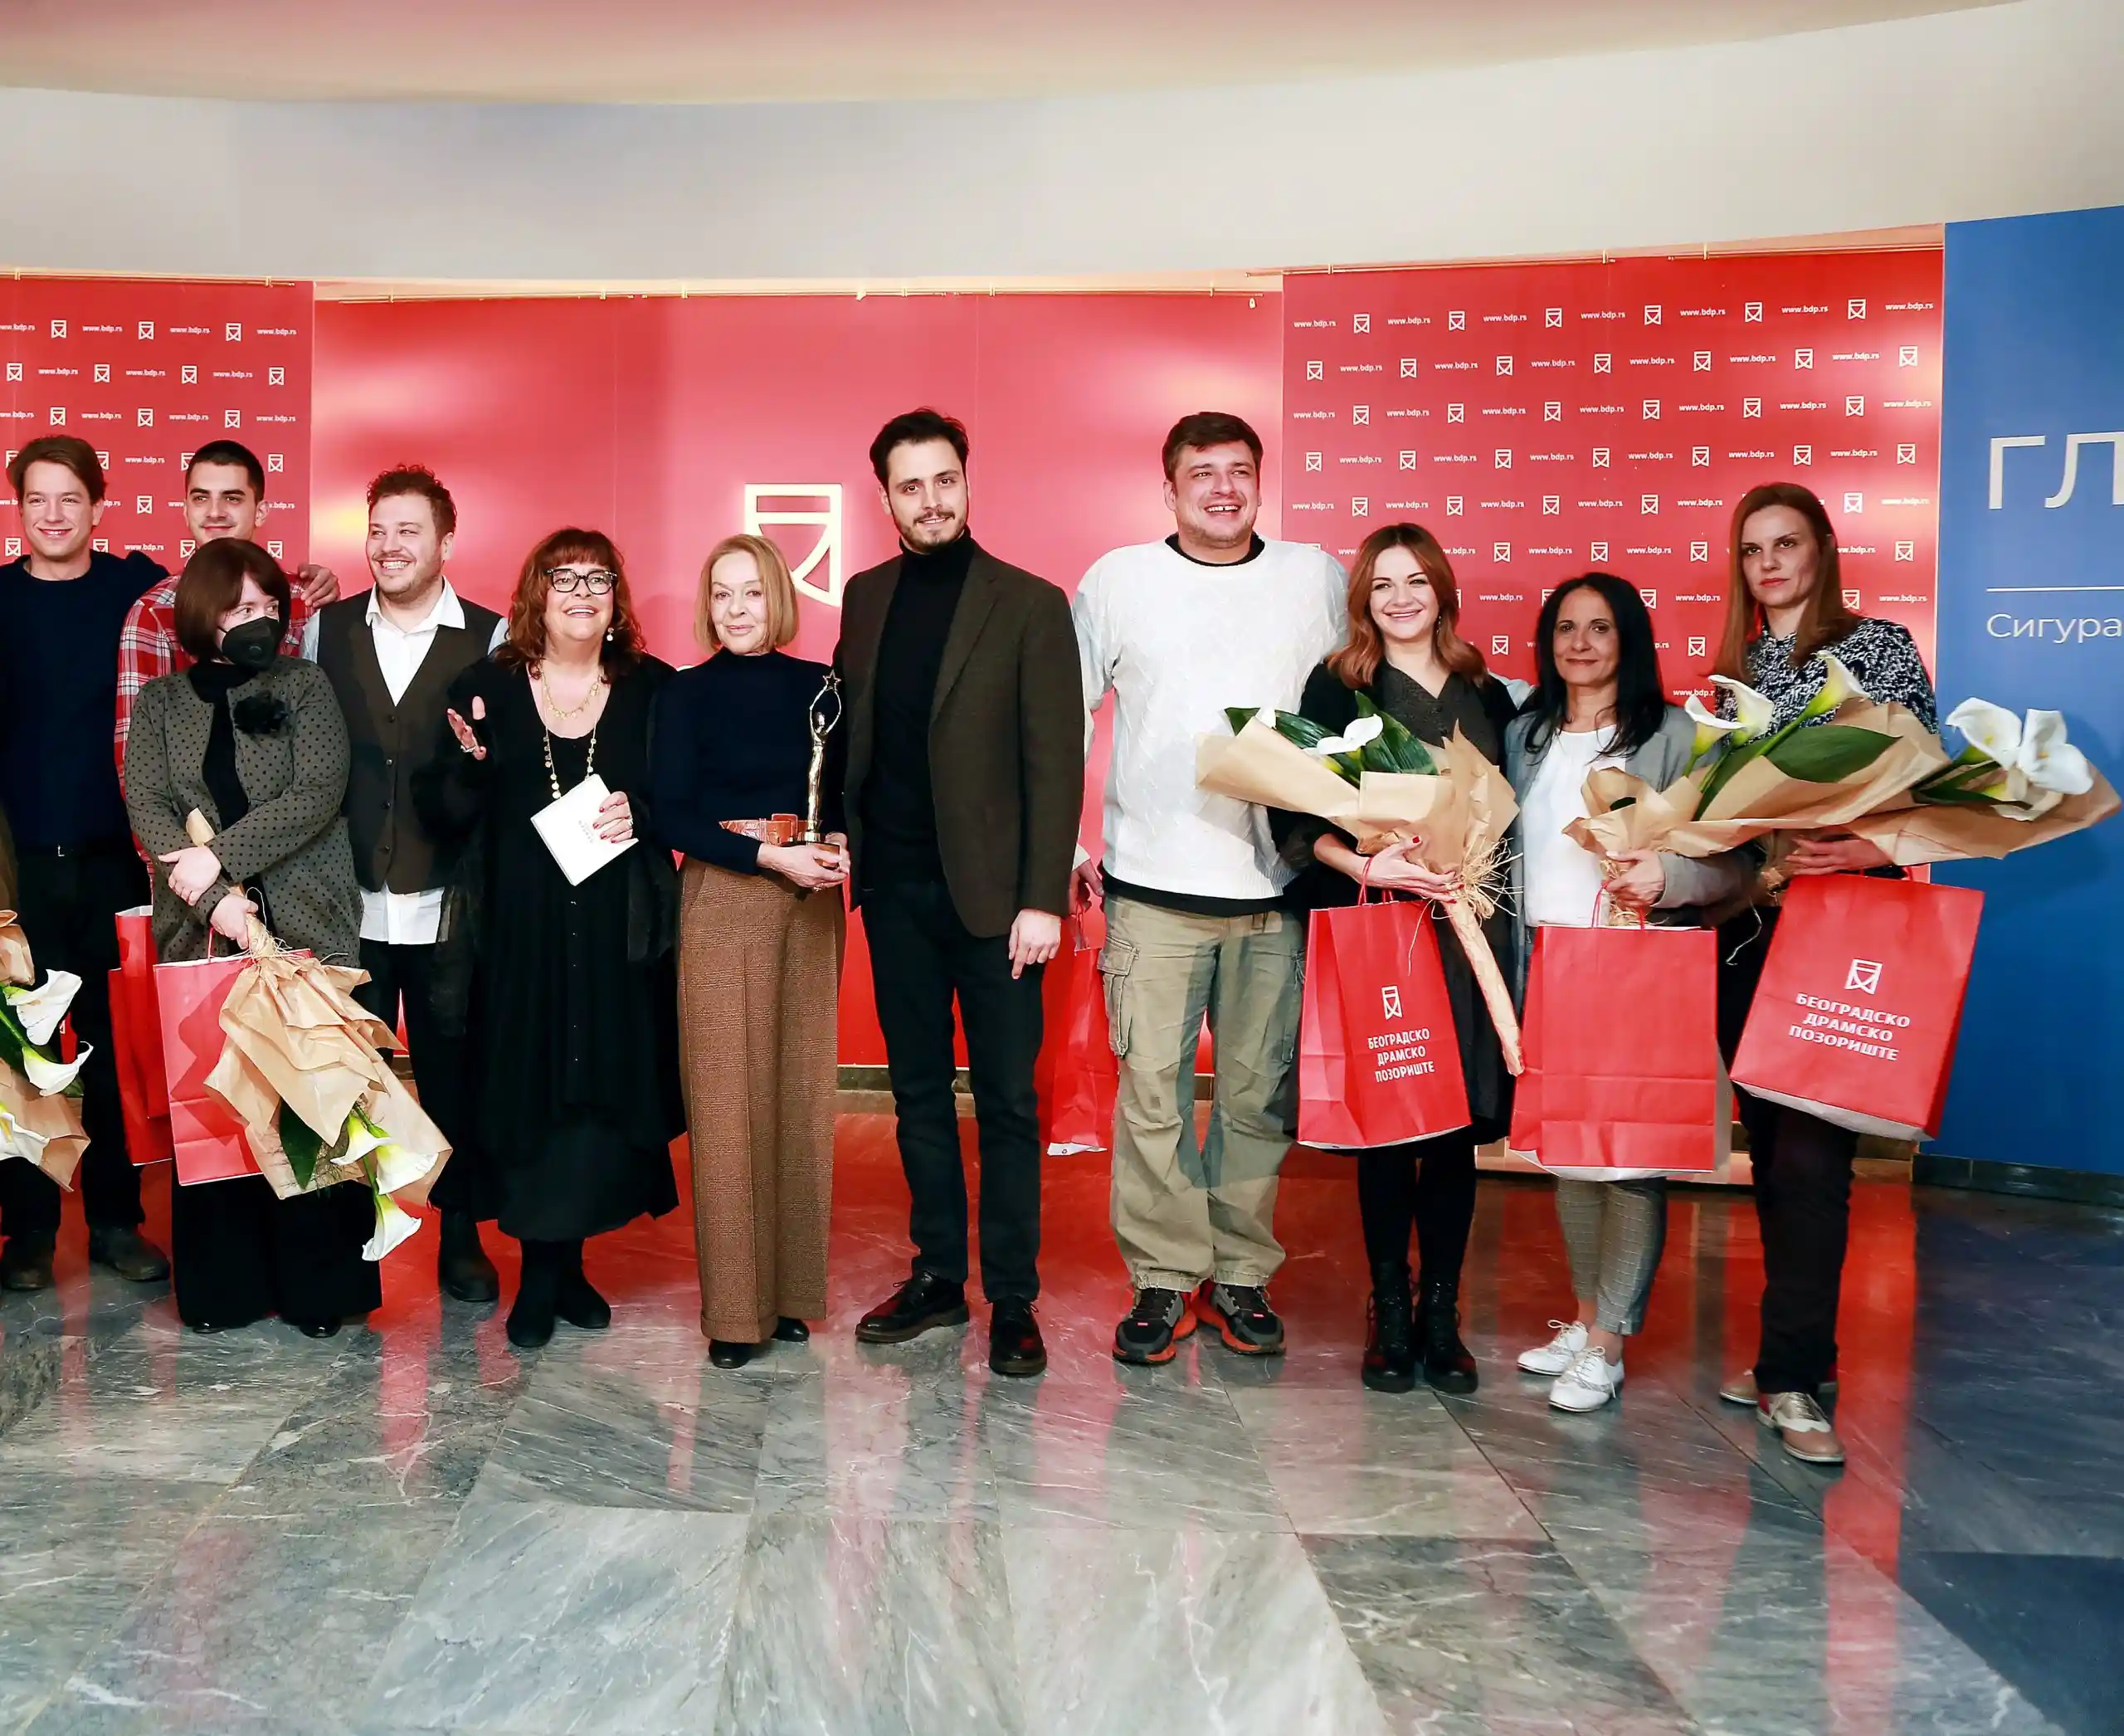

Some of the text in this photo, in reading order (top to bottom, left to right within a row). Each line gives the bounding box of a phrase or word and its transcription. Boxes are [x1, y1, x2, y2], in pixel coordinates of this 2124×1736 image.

[1781, 305, 1829, 315] www.bdp.rs
[1885, 301, 1934, 311] www.bdp.rs
[1581, 310, 1626, 319] www.bdp.rs
[1679, 308, 1726, 317] www.bdp.rs
[1293, 319, 1337, 328] www.bdp.rs
[1387, 316, 1431, 326] www.bdp.rs
[1483, 314, 1527, 323] www.bdp.rs
[82, 324, 123, 334] www.bdp.rs
[169, 326, 210, 335] www.bdp.rs
[256, 328, 297, 336] www.bdp.rs
[1630, 357, 1675, 366] www.bdp.rs
[1729, 354, 1776, 363] www.bdp.rs
[1832, 352, 1880, 362] www.bdp.rs
[1340, 363, 1383, 373] www.bdp.rs
[1434, 361, 1479, 371] www.bdp.rs
[1531, 358, 1576, 368] www.bdp.rs
[38, 367, 79, 376] www.bdp.rs
[125, 368, 166, 378] www.bdp.rs
[212, 370, 253, 379] www.bdp.rs
[1678, 403, 1725, 412] www.bdp.rs
[1779, 401, 1827, 411] www.bdp.rs
[1883, 399, 1932, 408] www.bdp.rs
[1386, 408, 1430, 418] www.bdp.rs
[1482, 407, 1527, 417] www.bdp.rs
[1579, 405, 1625, 414] www.bdp.rs
[80, 412, 122, 420] www.bdp.rs
[168, 413, 209, 422] www.bdp.rs
[256, 415, 296, 423] www.bdp.rs
[1293, 411, 1336, 420] www.bdp.rs
[1433, 454, 1478, 463] www.bdp.rs
[1529, 452, 1575, 461] www.bdp.rs
[1628, 451, 1673, 461] www.bdp.rs
[1728, 450, 1775, 460] www.bdp.rs
[1829, 449, 1878, 458] www.bdp.rs
[124, 456, 165, 465] www.bdp.rs
[1339, 455, 1382, 465] www.bdp.rs
[1292, 501, 1335, 511] www.bdp.rs
[1385, 500, 1429, 510] www.bdp.rs
[1480, 500, 1525, 510] www.bdp.rs
[1577, 499, 1624, 509] www.bdp.rs
[1677, 498, 1723, 508] www.bdp.rs
[124, 543, 165, 553] www.bdp.rs
[1528, 546, 1573, 555] www.bdp.rs
[1626, 546, 1672, 556] www.bdp.rs
[1479, 592, 1523, 602] www.bdp.rs
[1675, 593, 1721, 603] www.bdp.rs
[1878, 594, 1927, 604] www.bdp.rs
[1986, 613, 2122, 644] Сигура
[1673, 688, 1715, 698] www.bdp.r
[1795, 992, 1911, 1028] БЕОГРАДСКО
[1802, 1012, 1893, 1042] ДРАМСКО
[1367, 1028, 1430, 1050] БЕОГРАДСКО
[1788, 1025, 1899, 1061] ПОЗОРИШТЕ
[1377, 1046, 1426, 1067] ДРАМСКО
[1374, 1061, 1435, 1083] ПОЗОРИШТЕ
